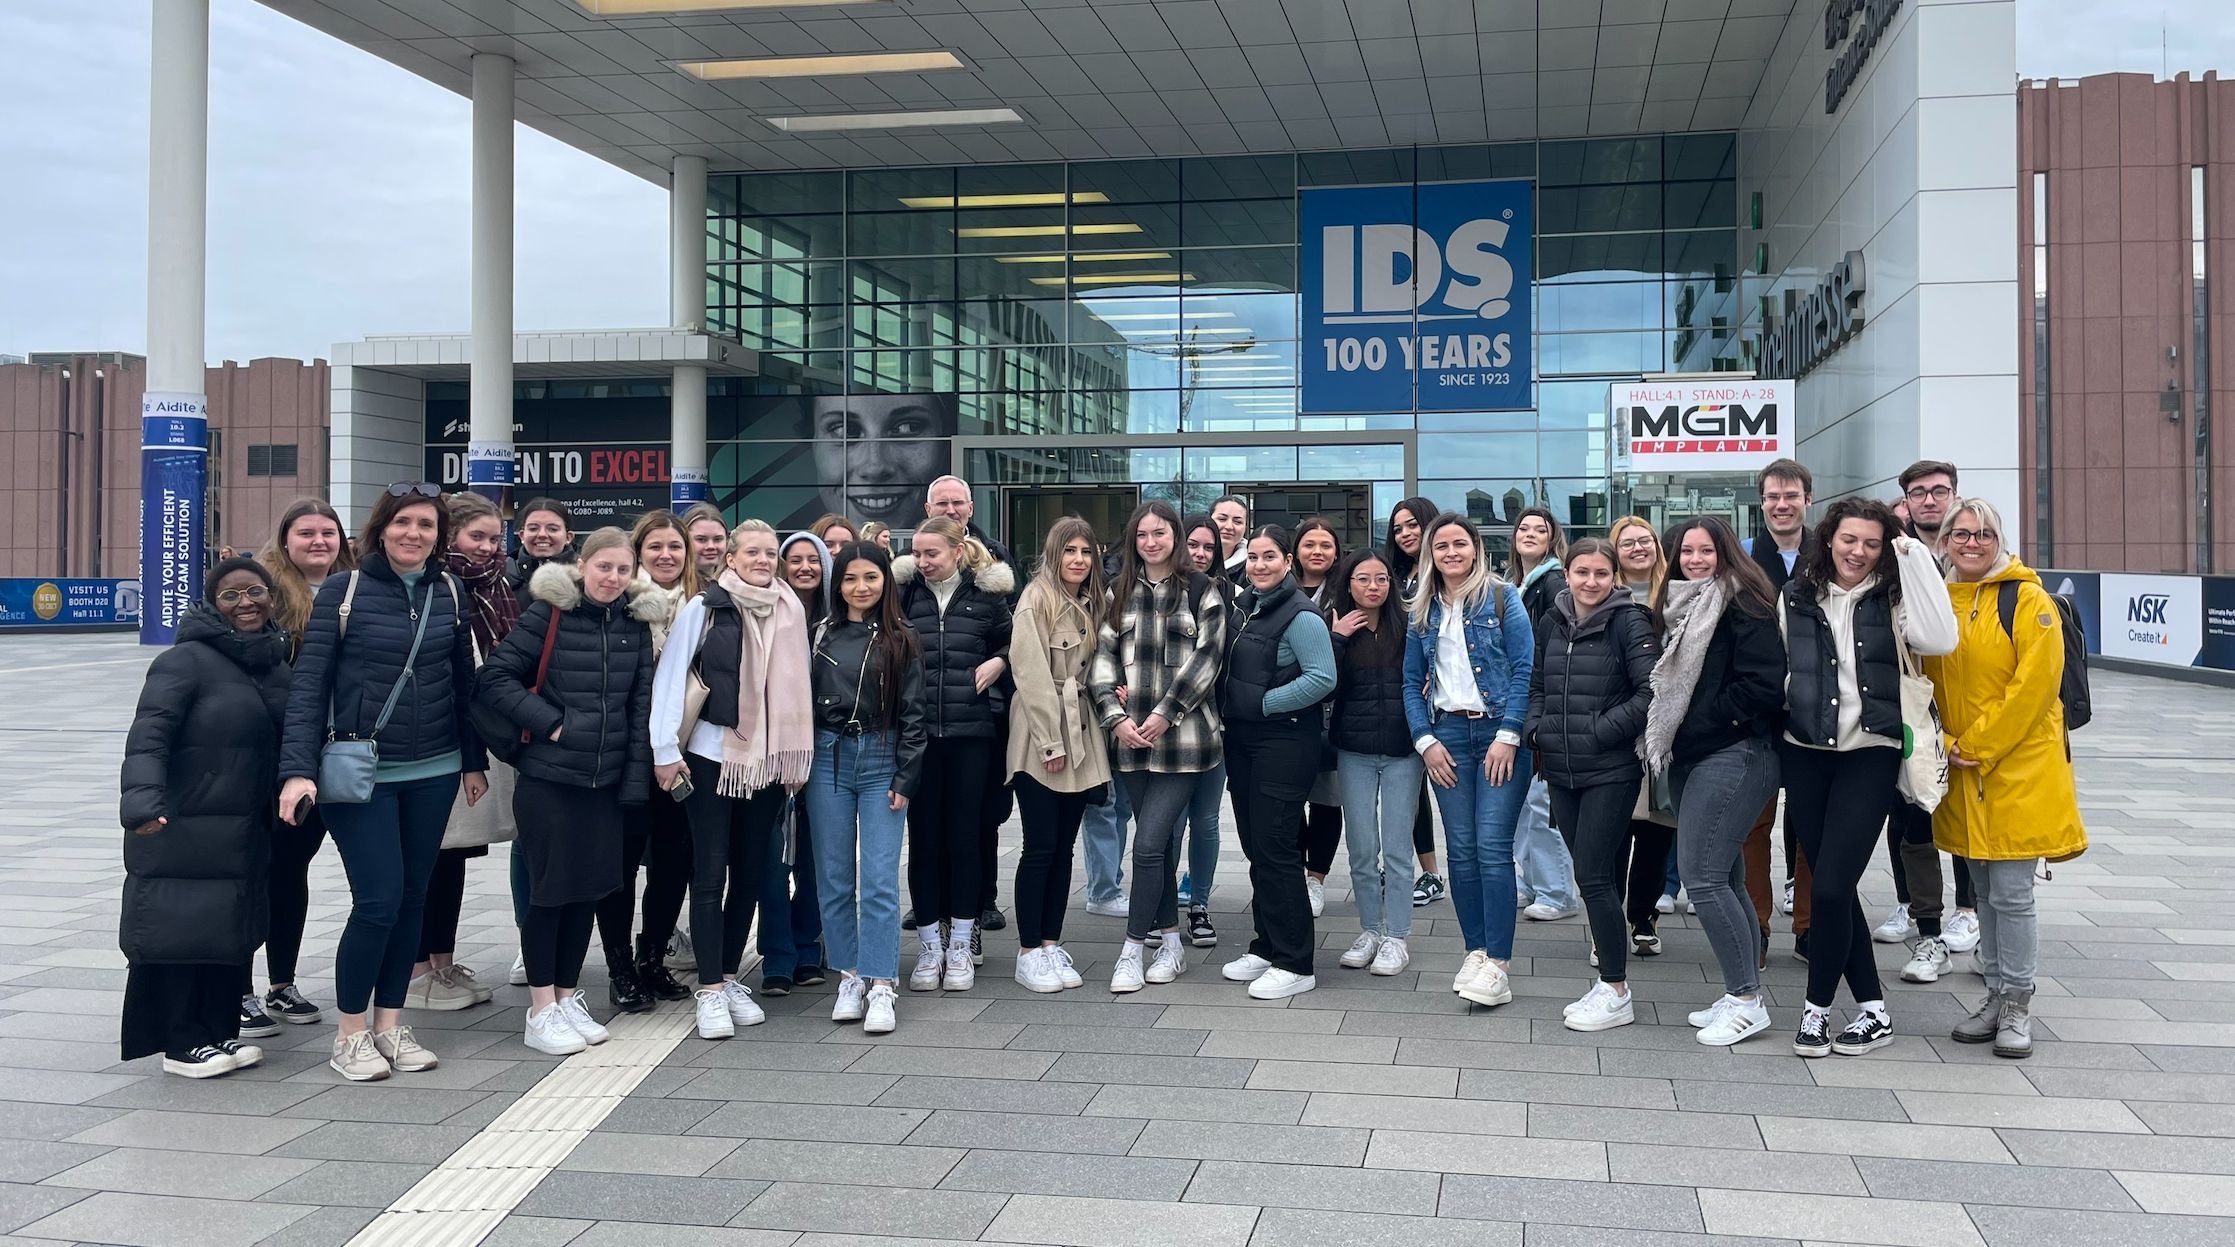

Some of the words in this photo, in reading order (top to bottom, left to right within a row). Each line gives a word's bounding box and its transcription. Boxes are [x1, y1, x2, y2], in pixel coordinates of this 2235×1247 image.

[1323, 218, 1514, 313] IDS
[1323, 337, 1388, 372] 100
[1397, 333, 1512, 370] YEARS
[1439, 373, 1476, 386] SINCE
[1481, 372, 1510, 385] 1923
[1692, 389, 1739, 401] STAND:
[156, 401, 196, 413] Aidite
[1631, 404, 1777, 437] MGM
[484, 448, 512, 457] Aidite
[1637, 440, 1769, 452] IMPLANT
[549, 451, 582, 484] TO
[590, 450, 672, 484] EXCEL
[573, 499, 580, 507] of
[581, 499, 618, 508] Excellence,
[163, 488, 175, 549] EFFICIENT
[178, 499, 190, 560] SOLUTION
[162, 552, 174, 586] YOUR
[68, 586, 94, 594] VISIT
[96, 586, 109, 594] US
[68, 598, 93, 606] BOOTH
[161, 589, 173, 628] AIDITE
[2128, 593, 2170, 624] NSK
[2128, 628, 2155, 643] Create
